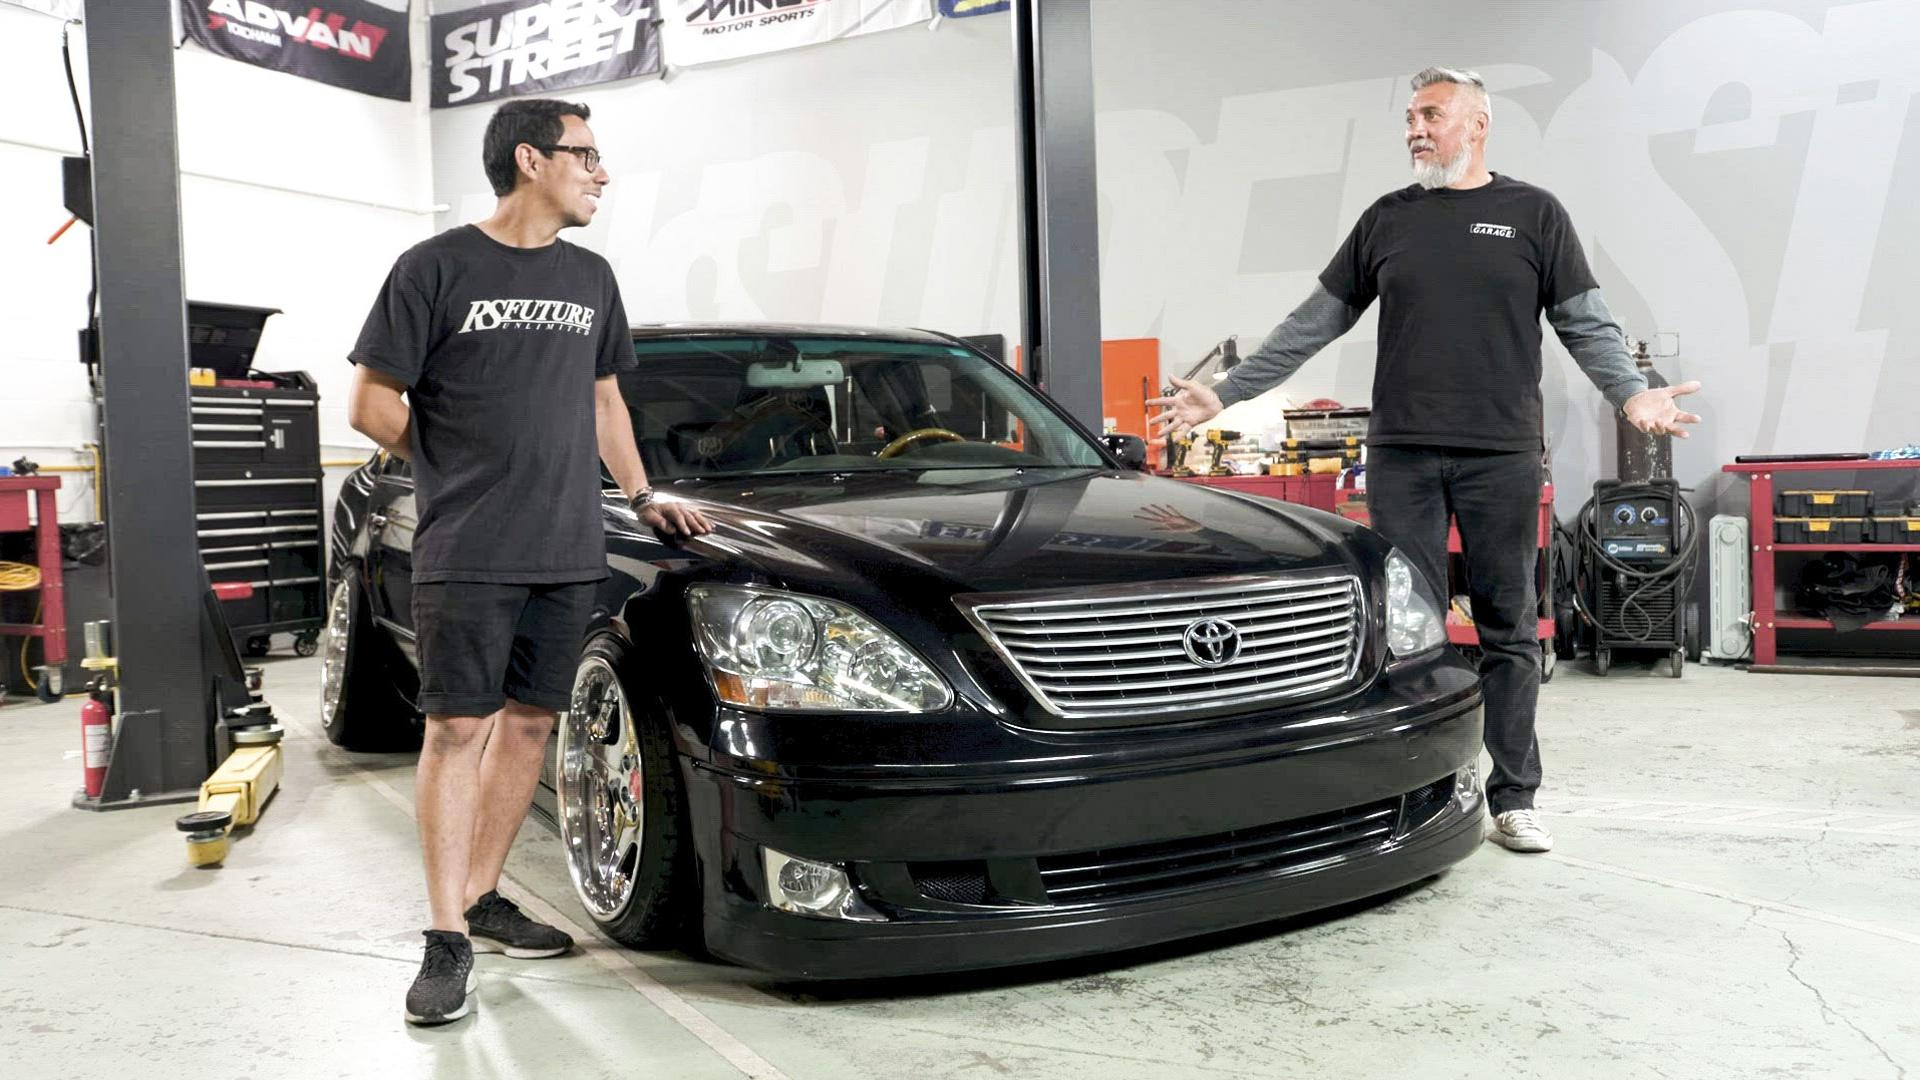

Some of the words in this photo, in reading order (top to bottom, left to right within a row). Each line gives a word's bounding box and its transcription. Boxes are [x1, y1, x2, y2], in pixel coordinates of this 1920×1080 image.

[207, 0, 372, 58] ADVAN
[444, 0, 640, 68] SUPER
[702, 20, 754, 36] MOTOR
[758, 8, 816, 27] SPORTS
[447, 7, 651, 104] STREET
[1473, 227, 1513, 238] GARAGE
